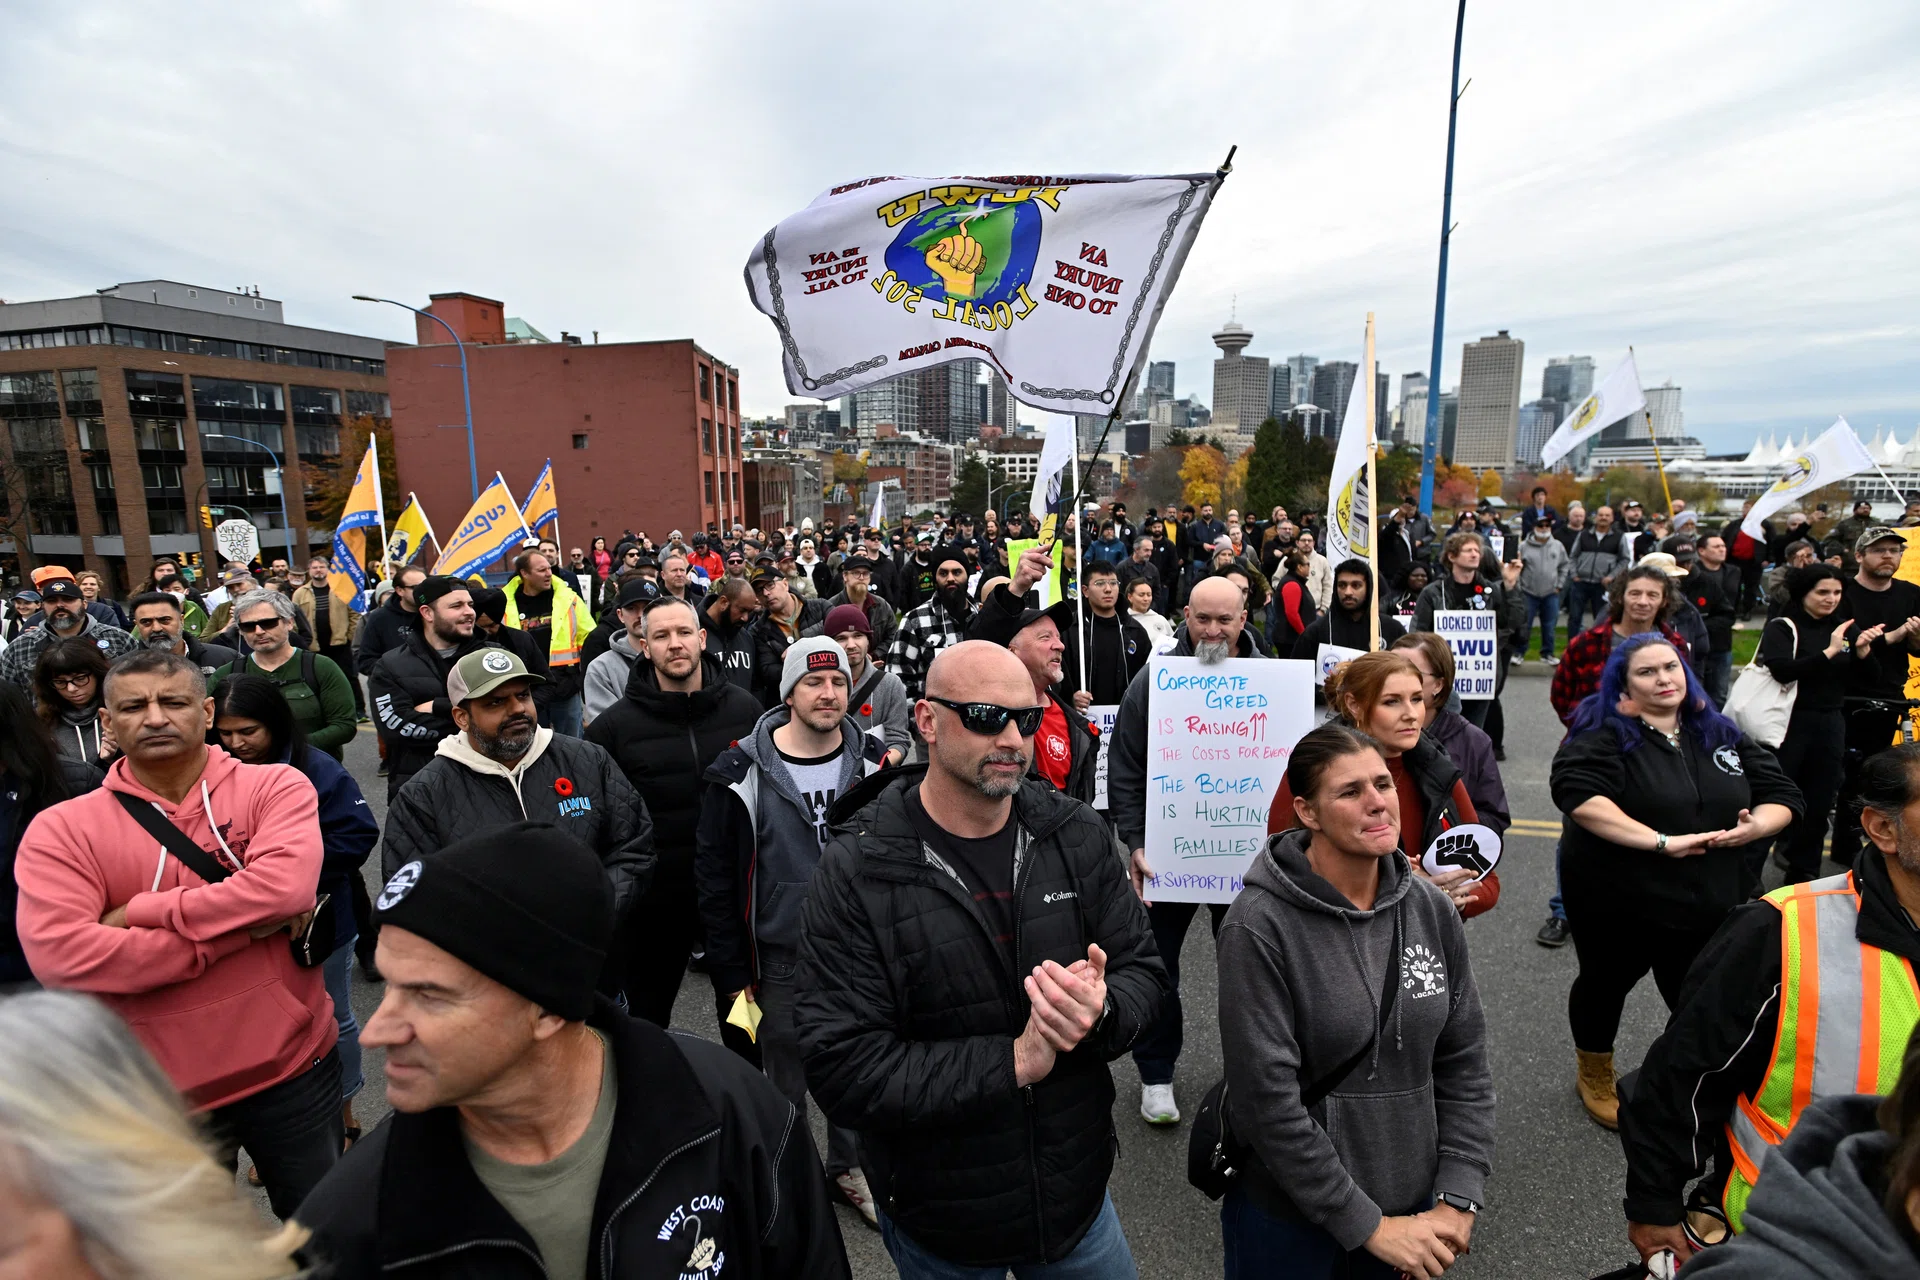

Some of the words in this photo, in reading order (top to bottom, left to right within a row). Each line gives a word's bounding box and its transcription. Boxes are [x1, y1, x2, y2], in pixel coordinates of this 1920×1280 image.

[217, 524, 255, 534] WHOSE
[220, 534, 250, 542] SIDE
[1436, 616, 1472, 630] LOCKED
[1476, 616, 1494, 630] OUT
[1446, 640, 1494, 656] LWU
[808, 653, 837, 664] ILWU
[1474, 660, 1492, 670] 514
[1157, 668, 1249, 691] CORPORATE
[1454, 678, 1472, 692] KED
[1476, 679, 1493, 692] OUT
[1206, 690, 1268, 710] GREED
[1158, 717, 1174, 735] IS
[1185, 715, 1249, 737] RAISING
[1158, 746, 1182, 762] THE
[1192, 745, 1230, 760] COSTS
[1238, 746, 1259, 760] FOR
[1263, 746, 1293, 760] EVERY
[1153, 775, 1185, 794] THE
[1195, 773, 1264, 794] BCMEA
[558, 796, 592, 817] ILWU
[1163, 803, 1176, 819] IS
[1174, 836, 1259, 855] FAMILIES
[1412, 990, 1436, 999] LOCAL
[657, 1204, 686, 1240] WEST
[690, 1195, 725, 1213] COAST
